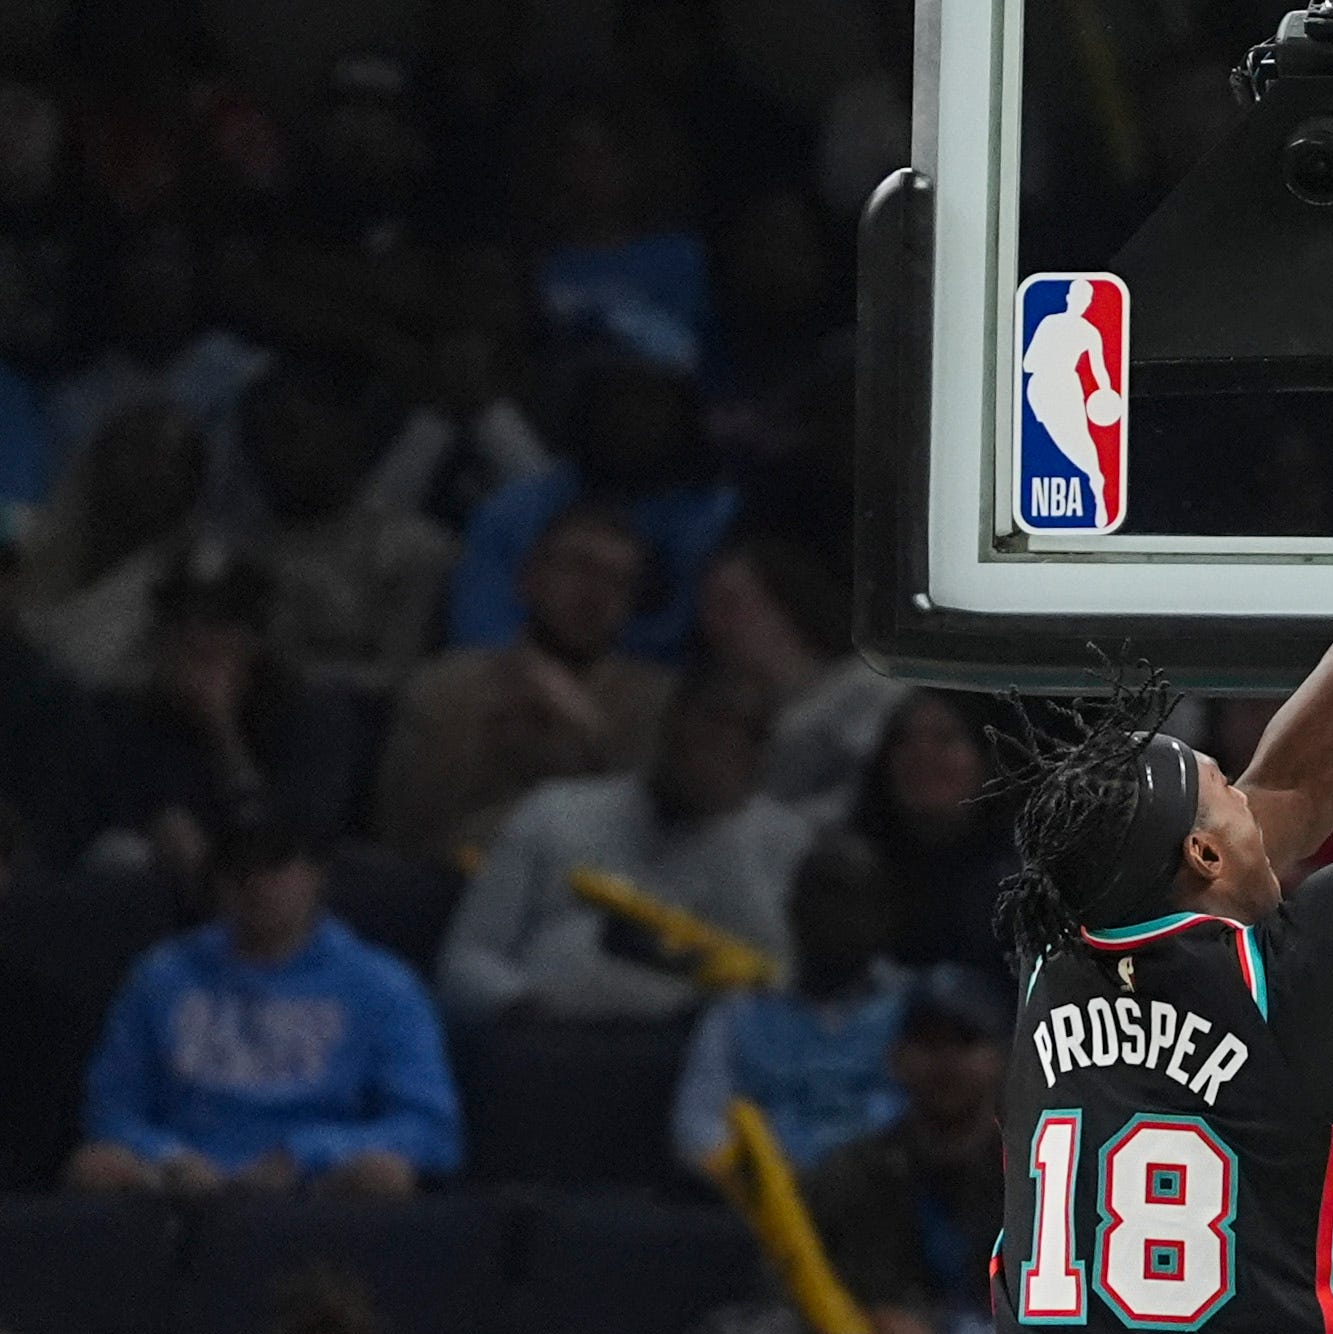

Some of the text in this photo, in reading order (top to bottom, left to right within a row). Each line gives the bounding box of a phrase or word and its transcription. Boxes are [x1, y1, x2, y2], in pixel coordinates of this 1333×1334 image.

[1031, 477, 1083, 517] NBA
[1033, 997, 1248, 1106] PROSPER
[1019, 1108, 1239, 1332] 18
